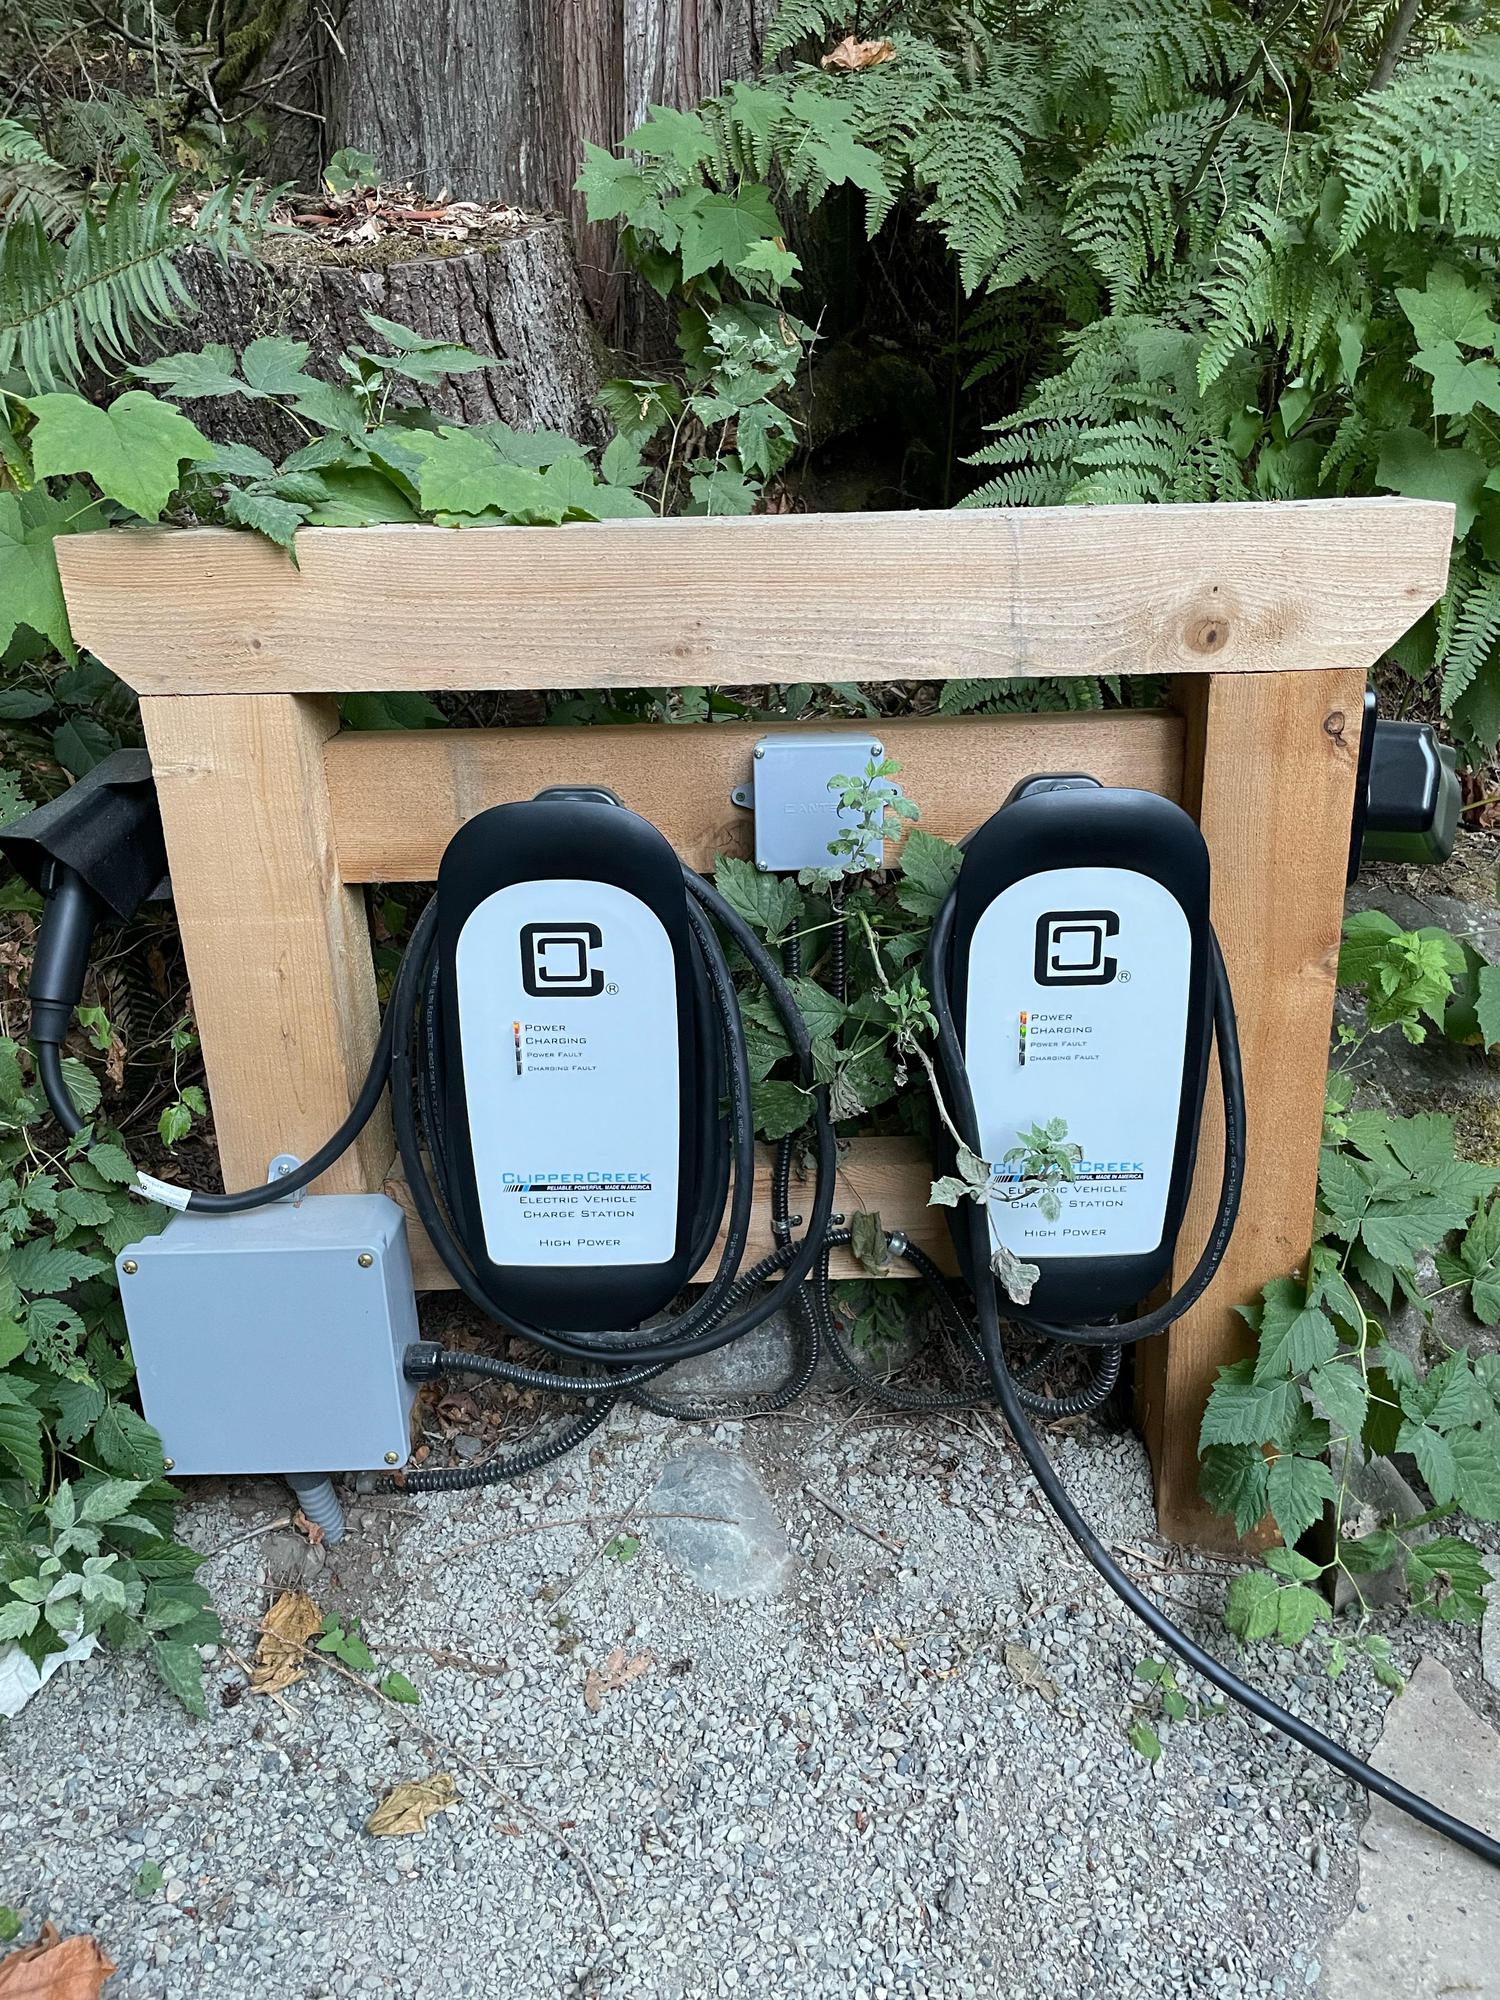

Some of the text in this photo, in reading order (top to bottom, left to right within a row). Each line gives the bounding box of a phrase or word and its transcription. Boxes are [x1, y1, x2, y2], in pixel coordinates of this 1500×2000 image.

[1031, 1013, 1073, 1022] POWER
[524, 1024, 566, 1032] POWER
[1030, 1026, 1093, 1034] CHARGING
[525, 1037, 587, 1045] CHARGING
[993, 1161, 1144, 1175] CLICREEK
[502, 1171, 651, 1184] CLIPPERCREEK
[1073, 1185, 1127, 1193] VEHICLE
[519, 1195, 637, 1204] ELECTRIC VEHICLE
[1011, 1199, 1124, 1209] CHA STATION
[523, 1210, 635, 1218] CHARGE STATION
[1024, 1228, 1107, 1237] HIGH POWER
[539, 1238, 621, 1247] HIGH POWER
